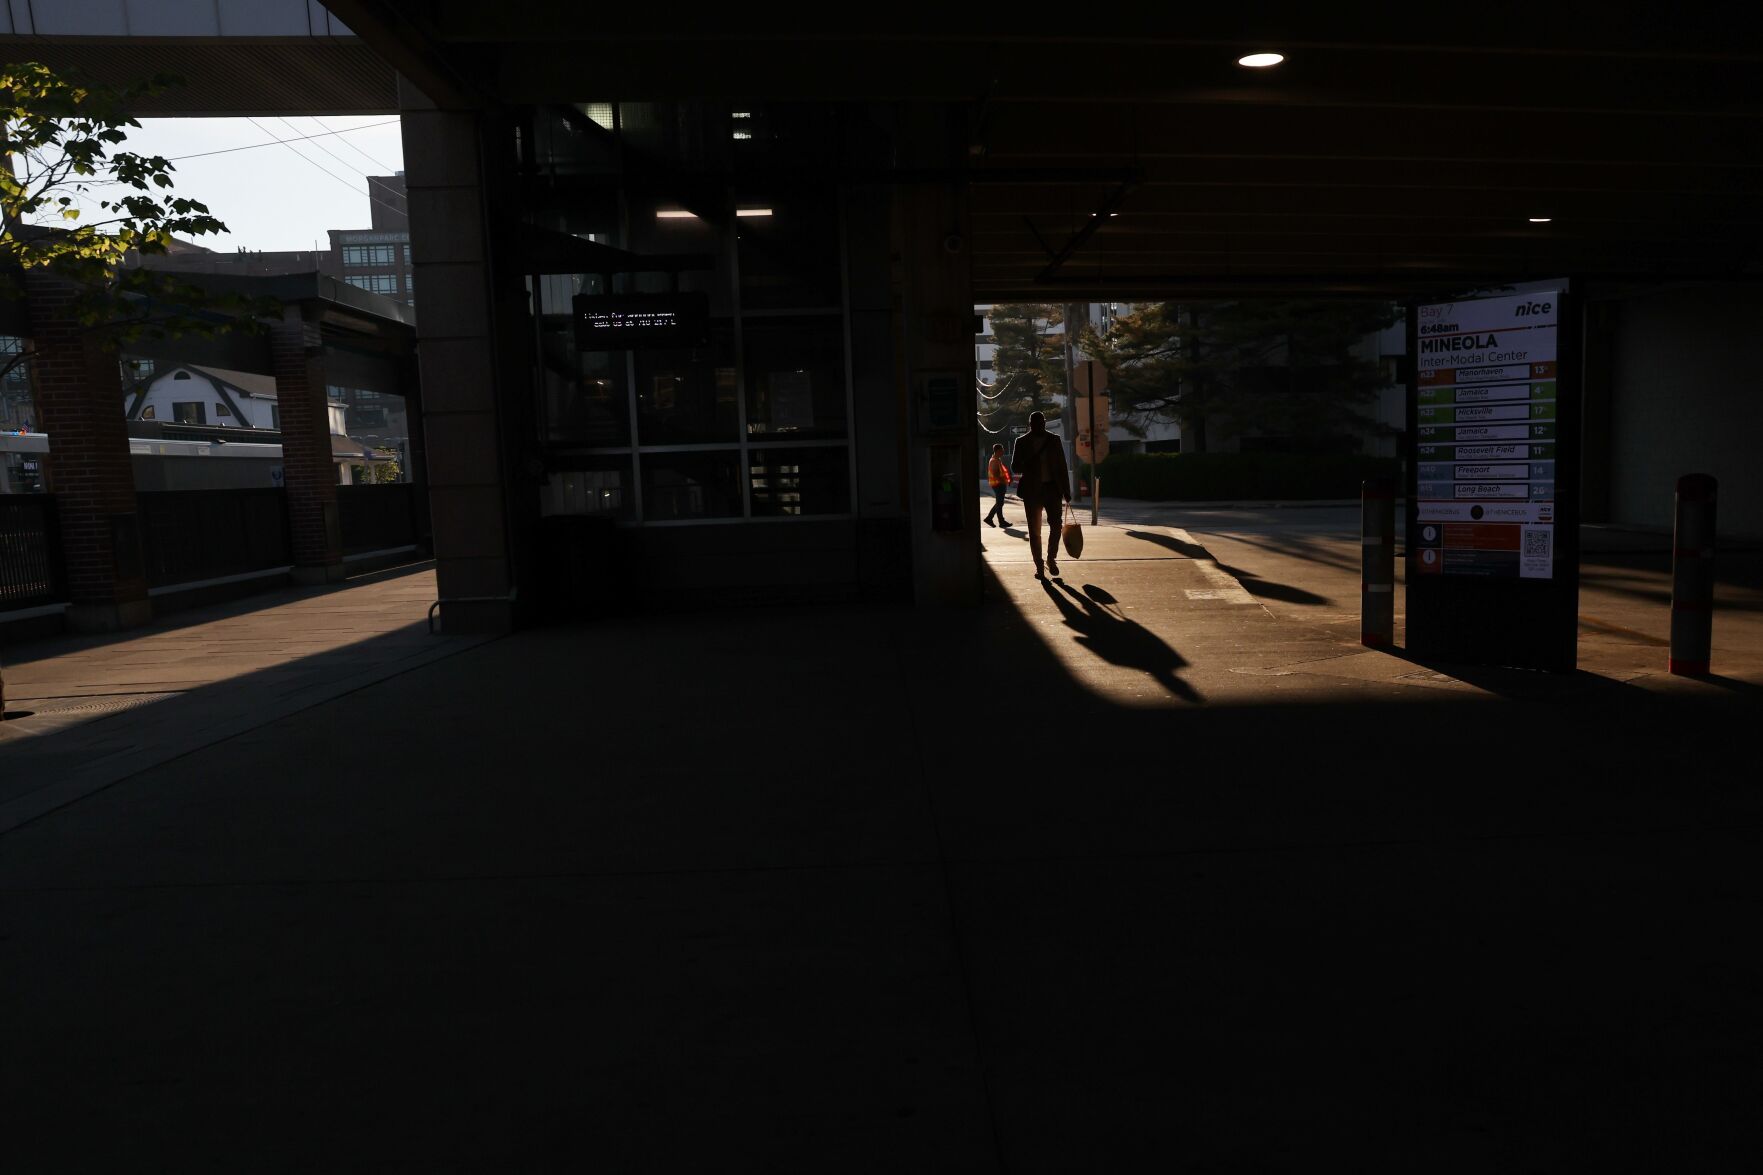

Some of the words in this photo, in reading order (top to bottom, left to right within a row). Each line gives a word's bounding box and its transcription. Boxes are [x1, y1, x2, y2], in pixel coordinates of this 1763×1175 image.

[1421, 307, 1441, 319] Bay
[1446, 303, 1454, 315] 7
[1515, 301, 1551, 317] nice
[1421, 323, 1459, 335] 6:48am
[1421, 334, 1498, 353] MINEOLA
[1421, 353, 1485, 368] Inter-Modal
[1488, 350, 1528, 363] Center
[1458, 368, 1504, 376] Manorhaven
[1458, 388, 1489, 397] Jamaica
[1458, 407, 1493, 415] Hicksville
[1458, 427, 1488, 435] Jamaica
[1458, 447, 1494, 455] Roosevelt
[1495, 446, 1515, 454] Field
[1458, 466, 1491, 474] Freeport
[1458, 485, 1476, 494] Long
[1477, 485, 1500, 493] Beach
